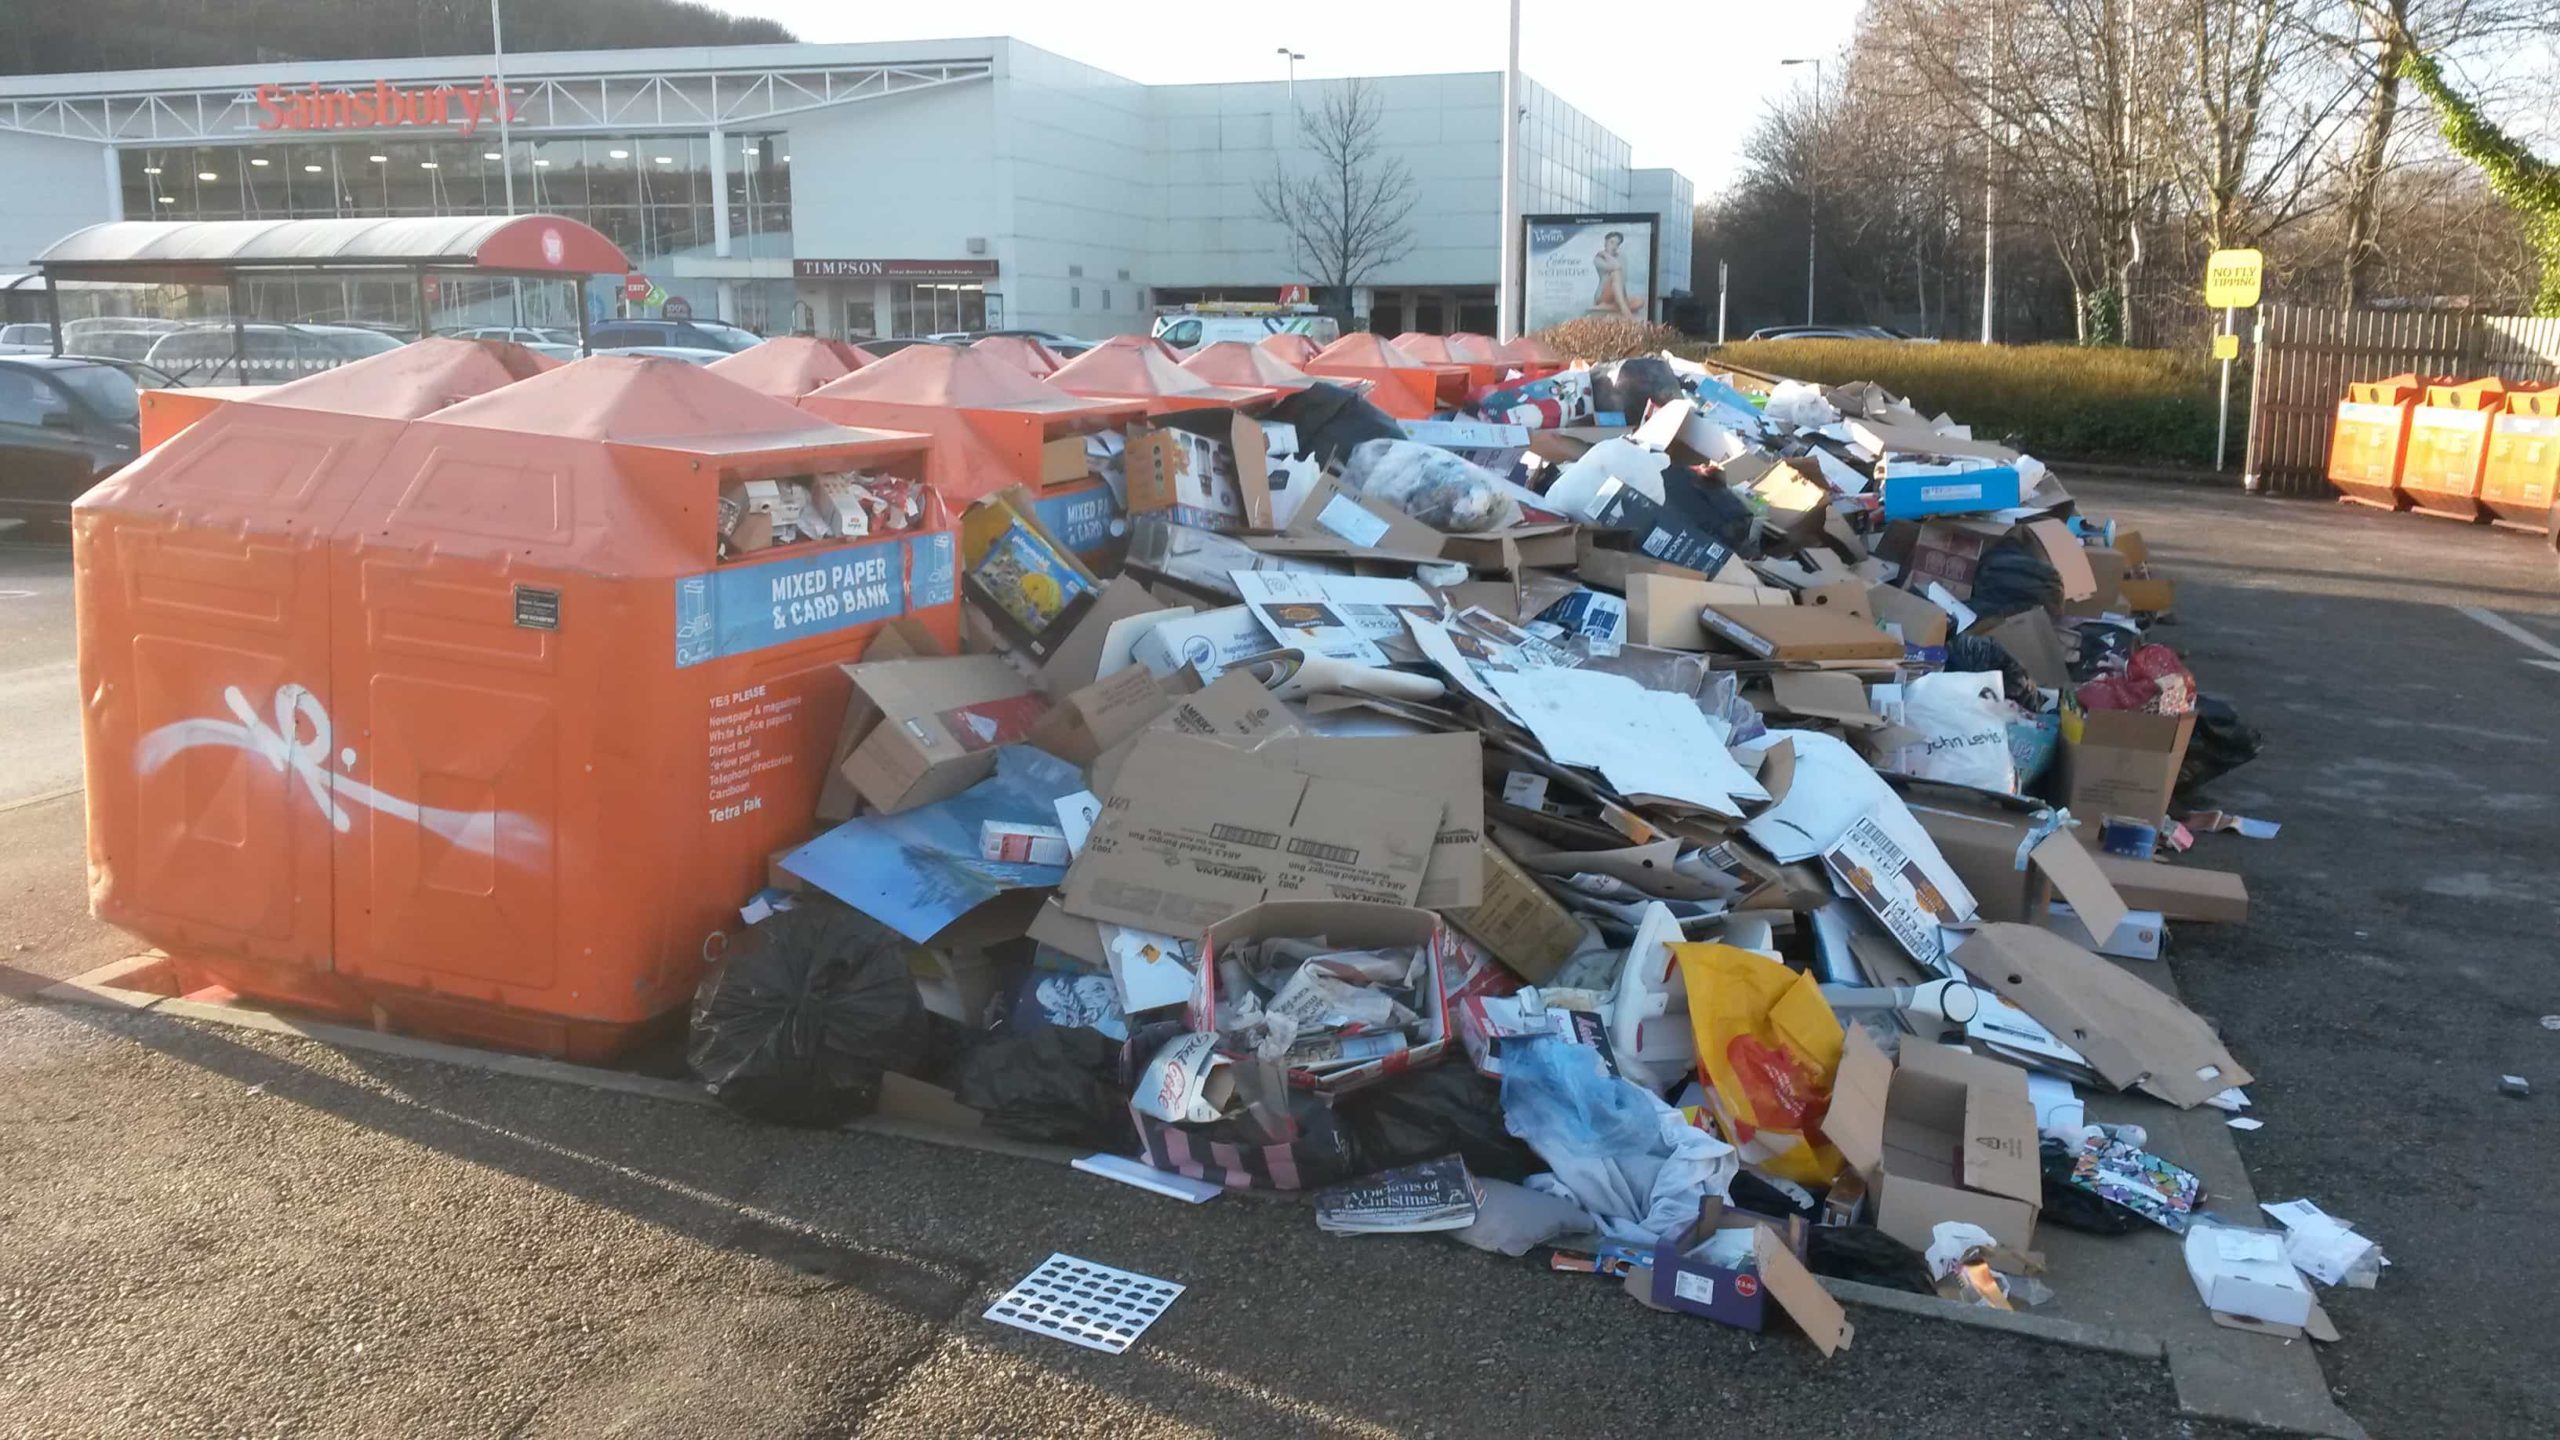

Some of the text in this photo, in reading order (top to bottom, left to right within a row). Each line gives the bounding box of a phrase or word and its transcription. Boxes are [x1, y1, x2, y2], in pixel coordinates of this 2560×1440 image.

[257, 74, 516, 137] Sainsbury's
[1533, 229, 1564, 242] Venus
[803, 262, 883, 275] TIMPSON
[2213, 267, 2256, 277] NO FLY
[2213, 278, 2256, 287] TIPPING
[1067, 502, 1095, 523] MIXED
[1663, 529, 1688, 561] SONY
[772, 557, 887, 602] MIXED PAPER
[772, 583, 890, 629] & CARD BANK
[709, 685, 766, 709] YES PLEASE
[709, 742, 736, 757] Direct
[709, 805, 740, 823] Tetra
[1195, 866, 1268, 885] AMERICANA
[1172, 1032, 1210, 1066] Diet
[1157, 1061, 1187, 1111] Coke
